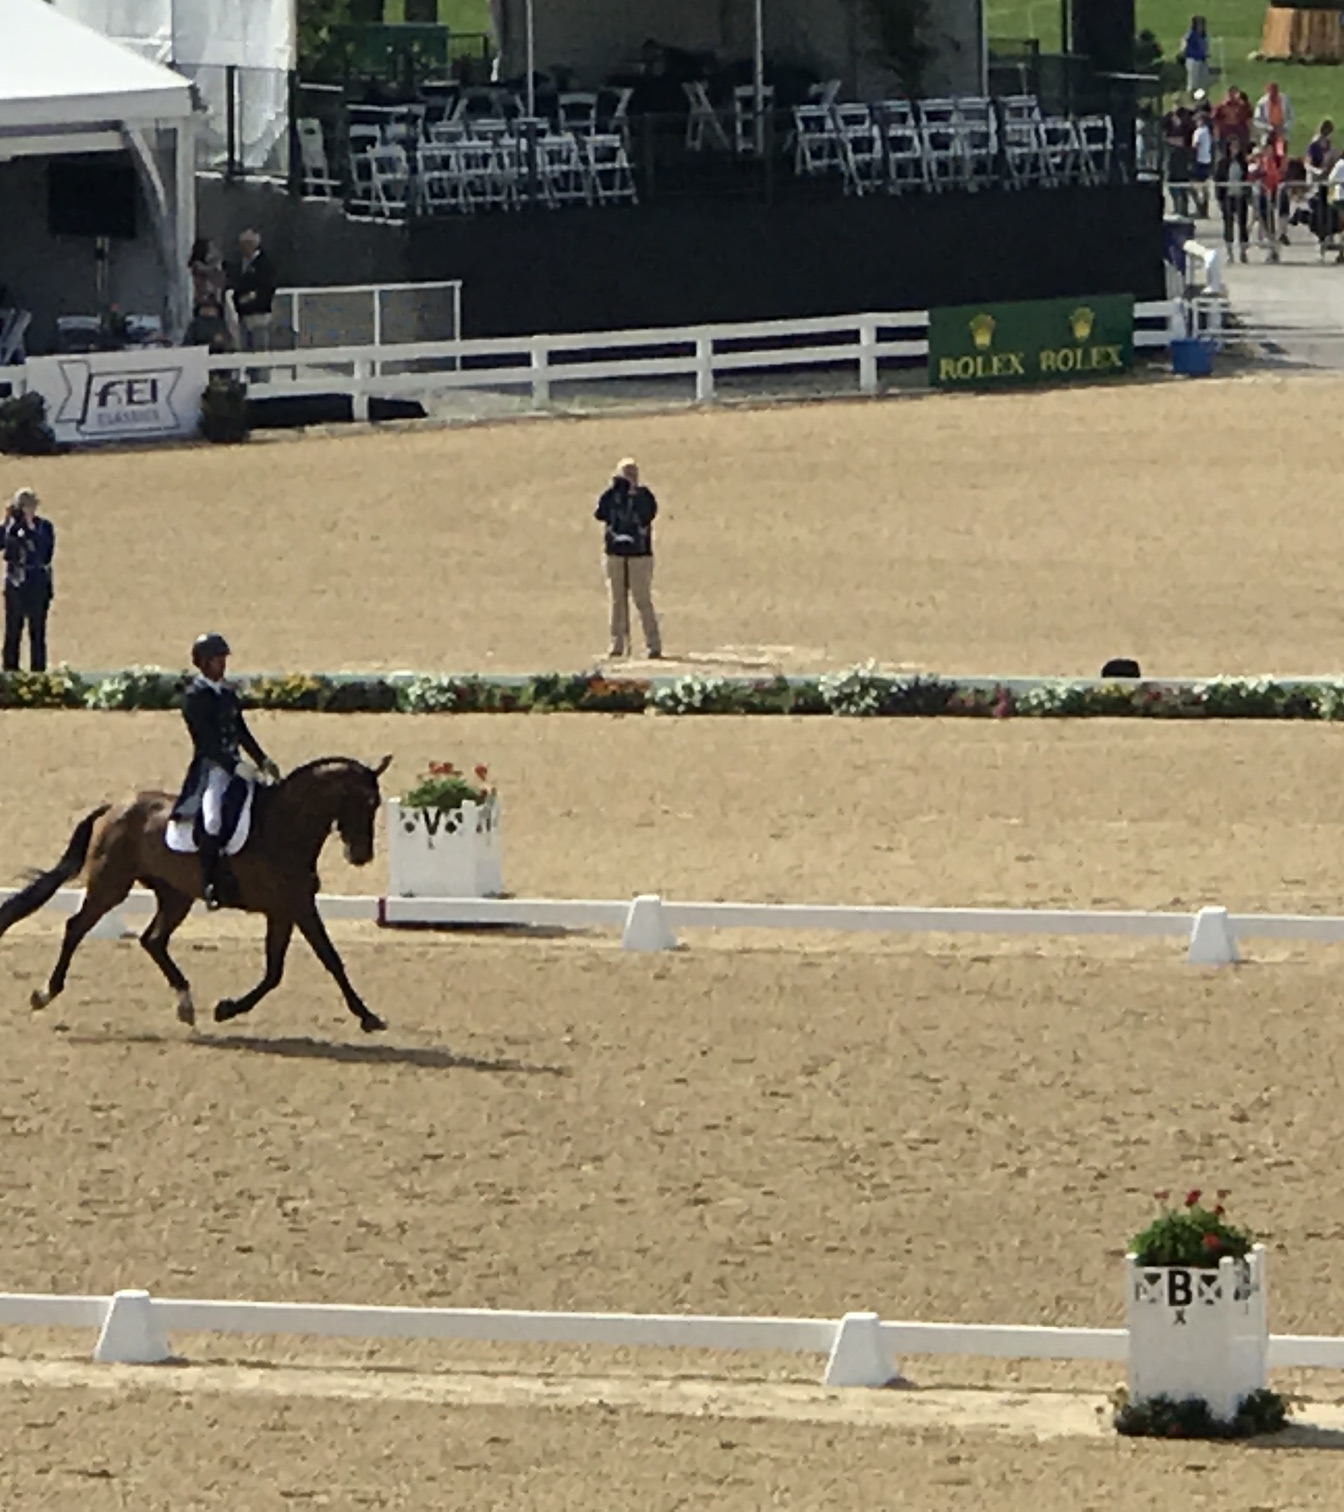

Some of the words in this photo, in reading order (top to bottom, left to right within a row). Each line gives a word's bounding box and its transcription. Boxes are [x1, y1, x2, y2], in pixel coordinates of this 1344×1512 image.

[939, 352, 1025, 381] ROLEX
[1039, 345, 1123, 372] ROLEX
[422, 805, 442, 836] V
[1168, 1269, 1193, 1307] B
